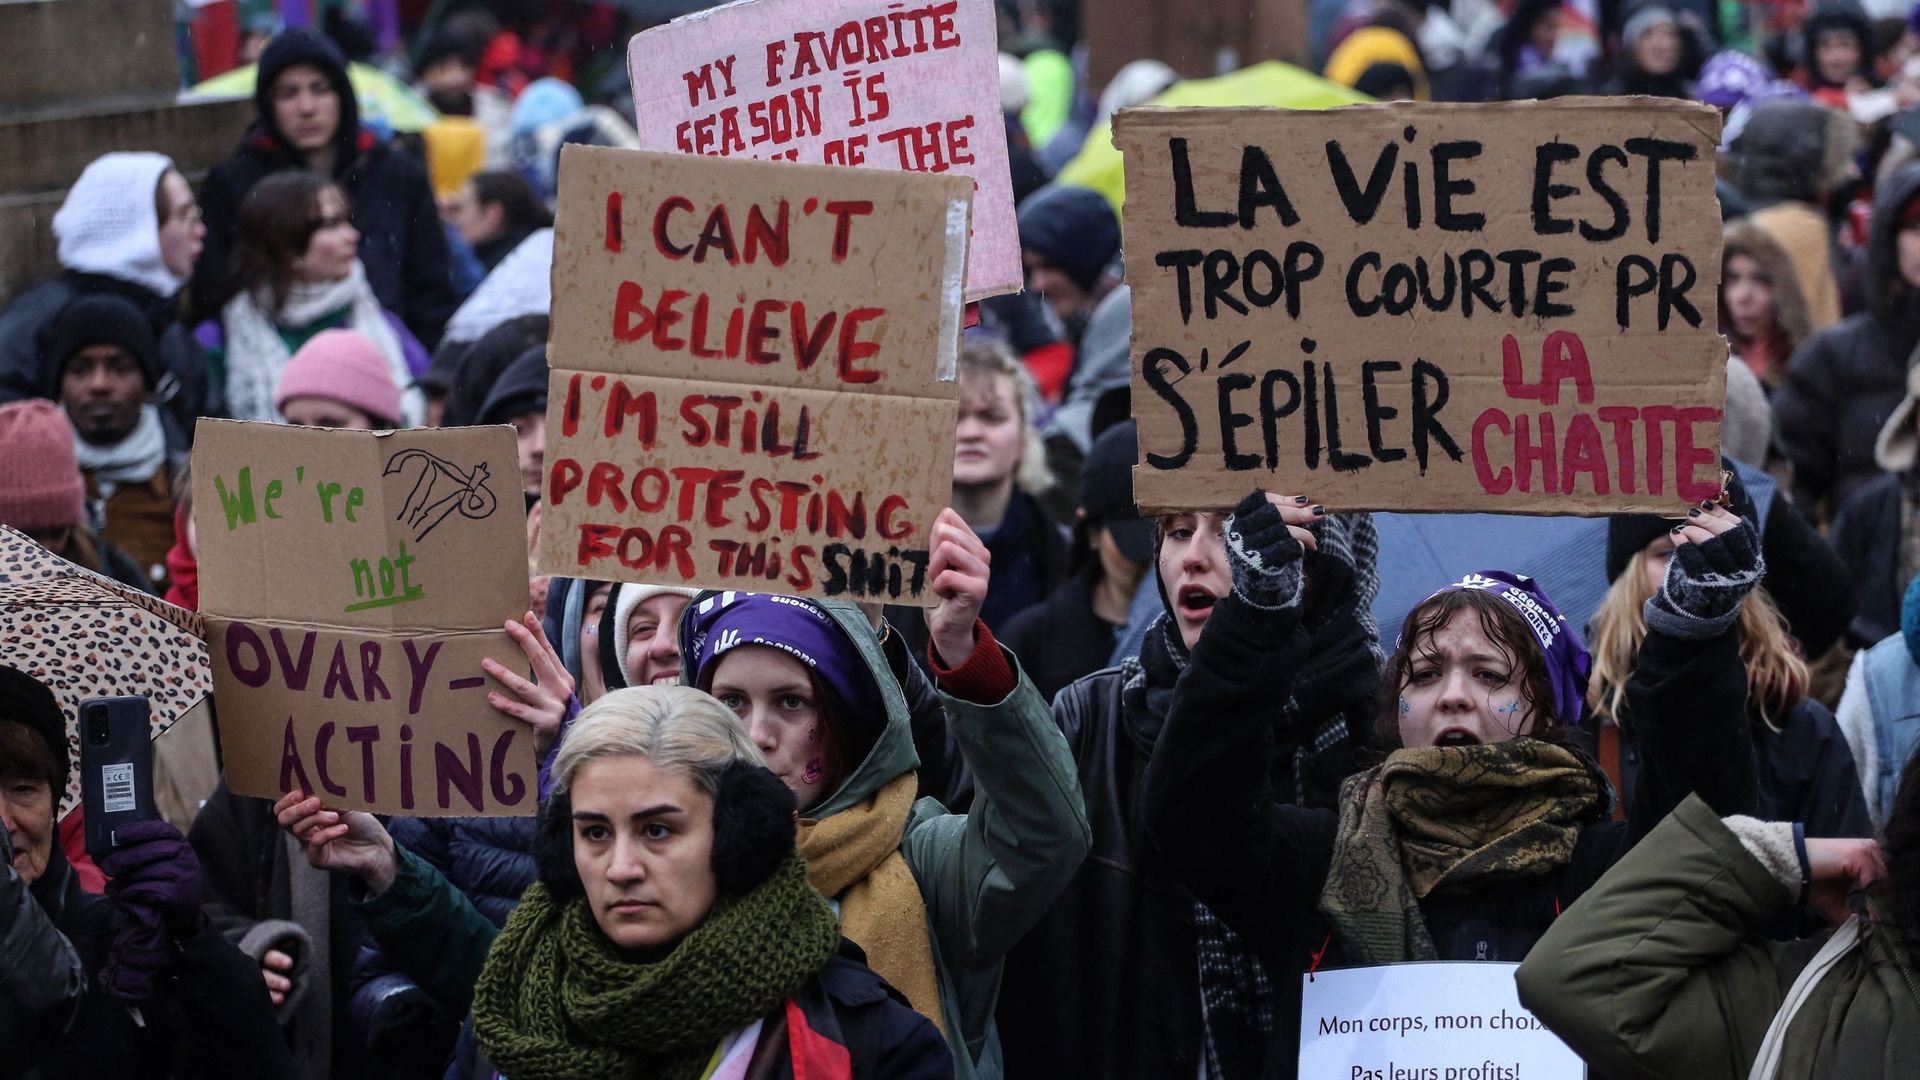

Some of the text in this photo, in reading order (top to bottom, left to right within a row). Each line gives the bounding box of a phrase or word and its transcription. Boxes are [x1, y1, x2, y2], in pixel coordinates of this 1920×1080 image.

[683, 0, 961, 107] MY FAVORITE
[676, 70, 890, 156] SEASON IS
[878, 115, 975, 173] THE
[1169, 137, 1300, 230] LA
[1531, 135, 1698, 244] EST
[605, 191, 874, 267] I CAN'T
[1154, 241, 1703, 331] TROP COURTE PR
[1502, 330, 1595, 405] LA
[562, 372, 657, 451] I'M
[1471, 406, 1723, 502] CHATTE
[213, 465, 364, 532] We're
[349, 539, 424, 599] not
[577, 523, 696, 580] FOR
[1509, 587, 1561, 635] Gagnons
[1318, 1016, 1363, 1036] Mon
[1369, 1015, 1428, 1037] corps,
[1434, 1014, 1482, 1030] mon
[1351, 1060, 1520, 1080] Pas leurs profits!
